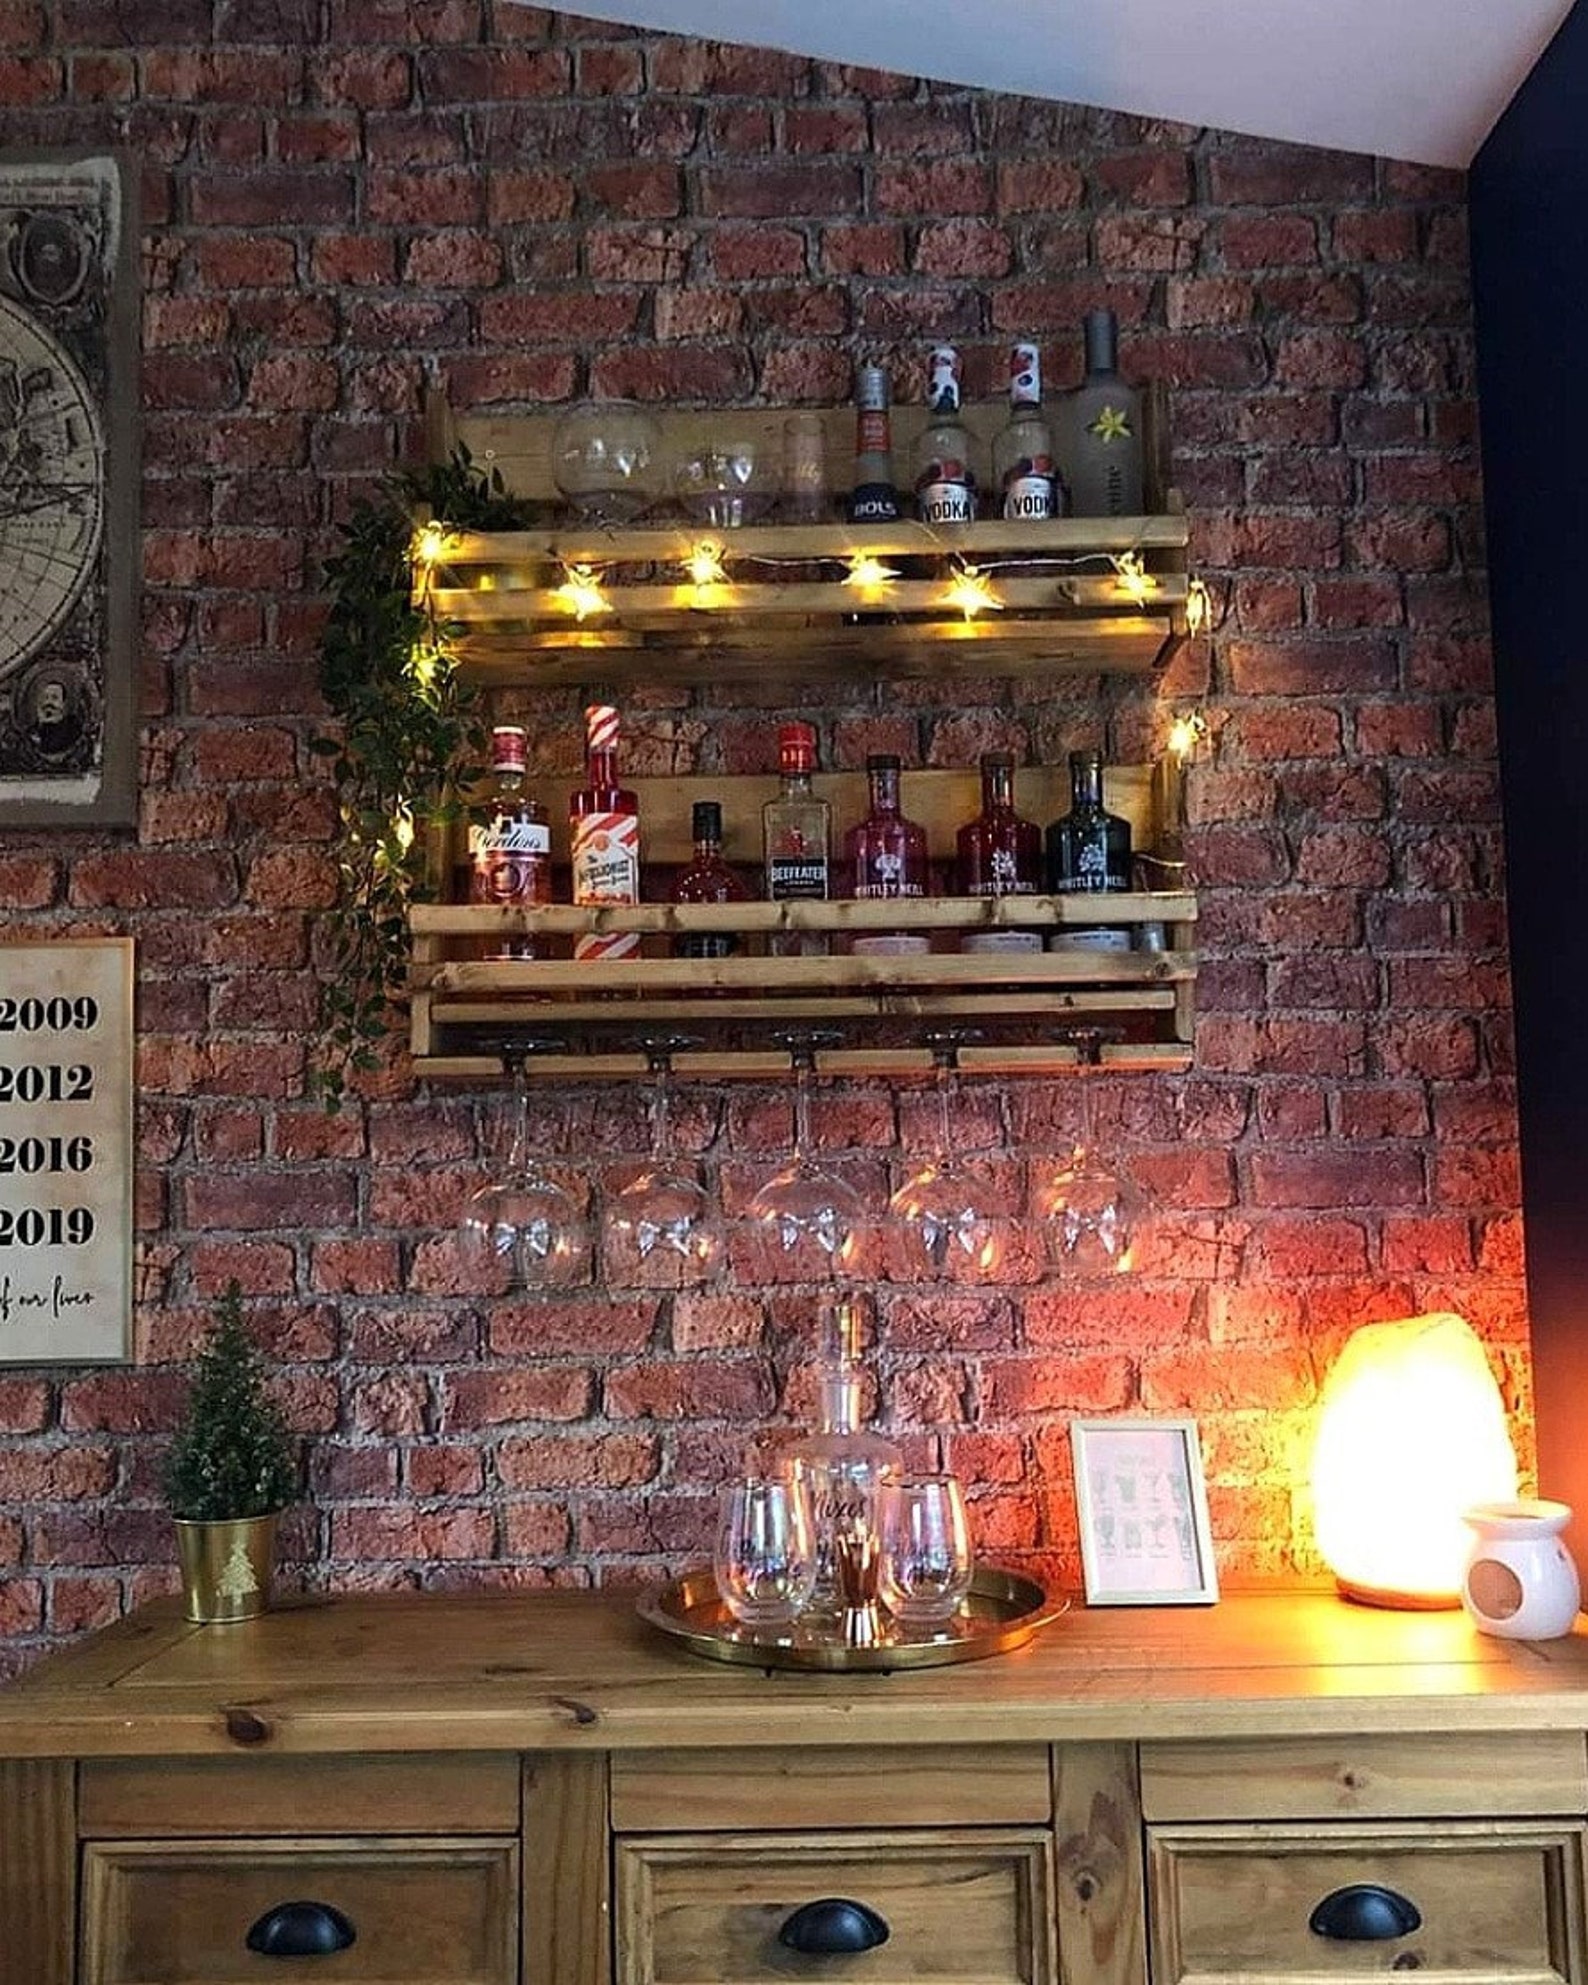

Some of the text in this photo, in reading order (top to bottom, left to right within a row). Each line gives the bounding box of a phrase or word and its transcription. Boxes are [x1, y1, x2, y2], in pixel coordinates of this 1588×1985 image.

[854, 501, 897, 518] BOLS
[923, 501, 973, 521] VODKA
[772, 866, 827, 882] BEEFEATER
[0, 997, 97, 1031] 2009
[0, 1065, 92, 1101] 2012
[0, 1137, 92, 1173] 2016
[0, 1209, 93, 1245] 2019
